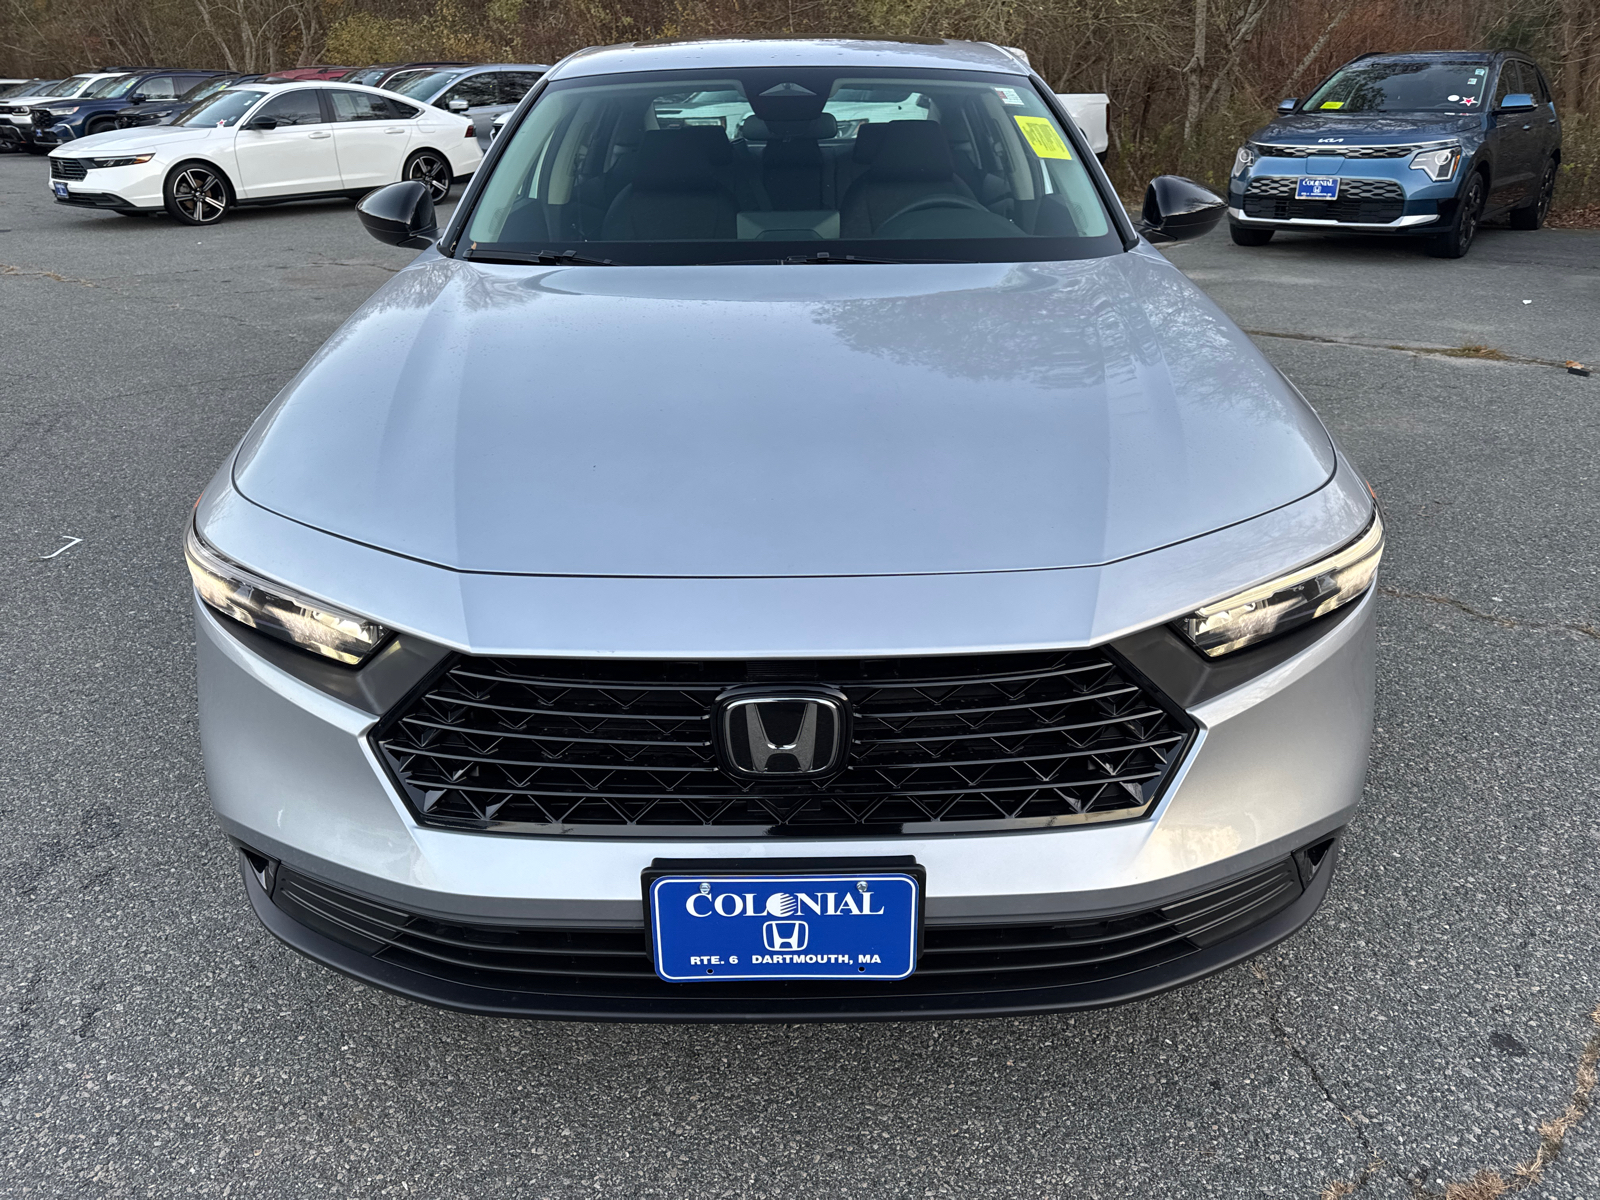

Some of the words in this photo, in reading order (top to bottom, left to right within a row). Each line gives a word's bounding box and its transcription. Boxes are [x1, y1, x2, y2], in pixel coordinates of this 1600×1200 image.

[685, 891, 885, 918] COLONIAL
[690, 955, 725, 965] RTE.
[728, 955, 739, 965] 6
[751, 954, 854, 965] DARTMOUTH,
[858, 954, 882, 964] MA
